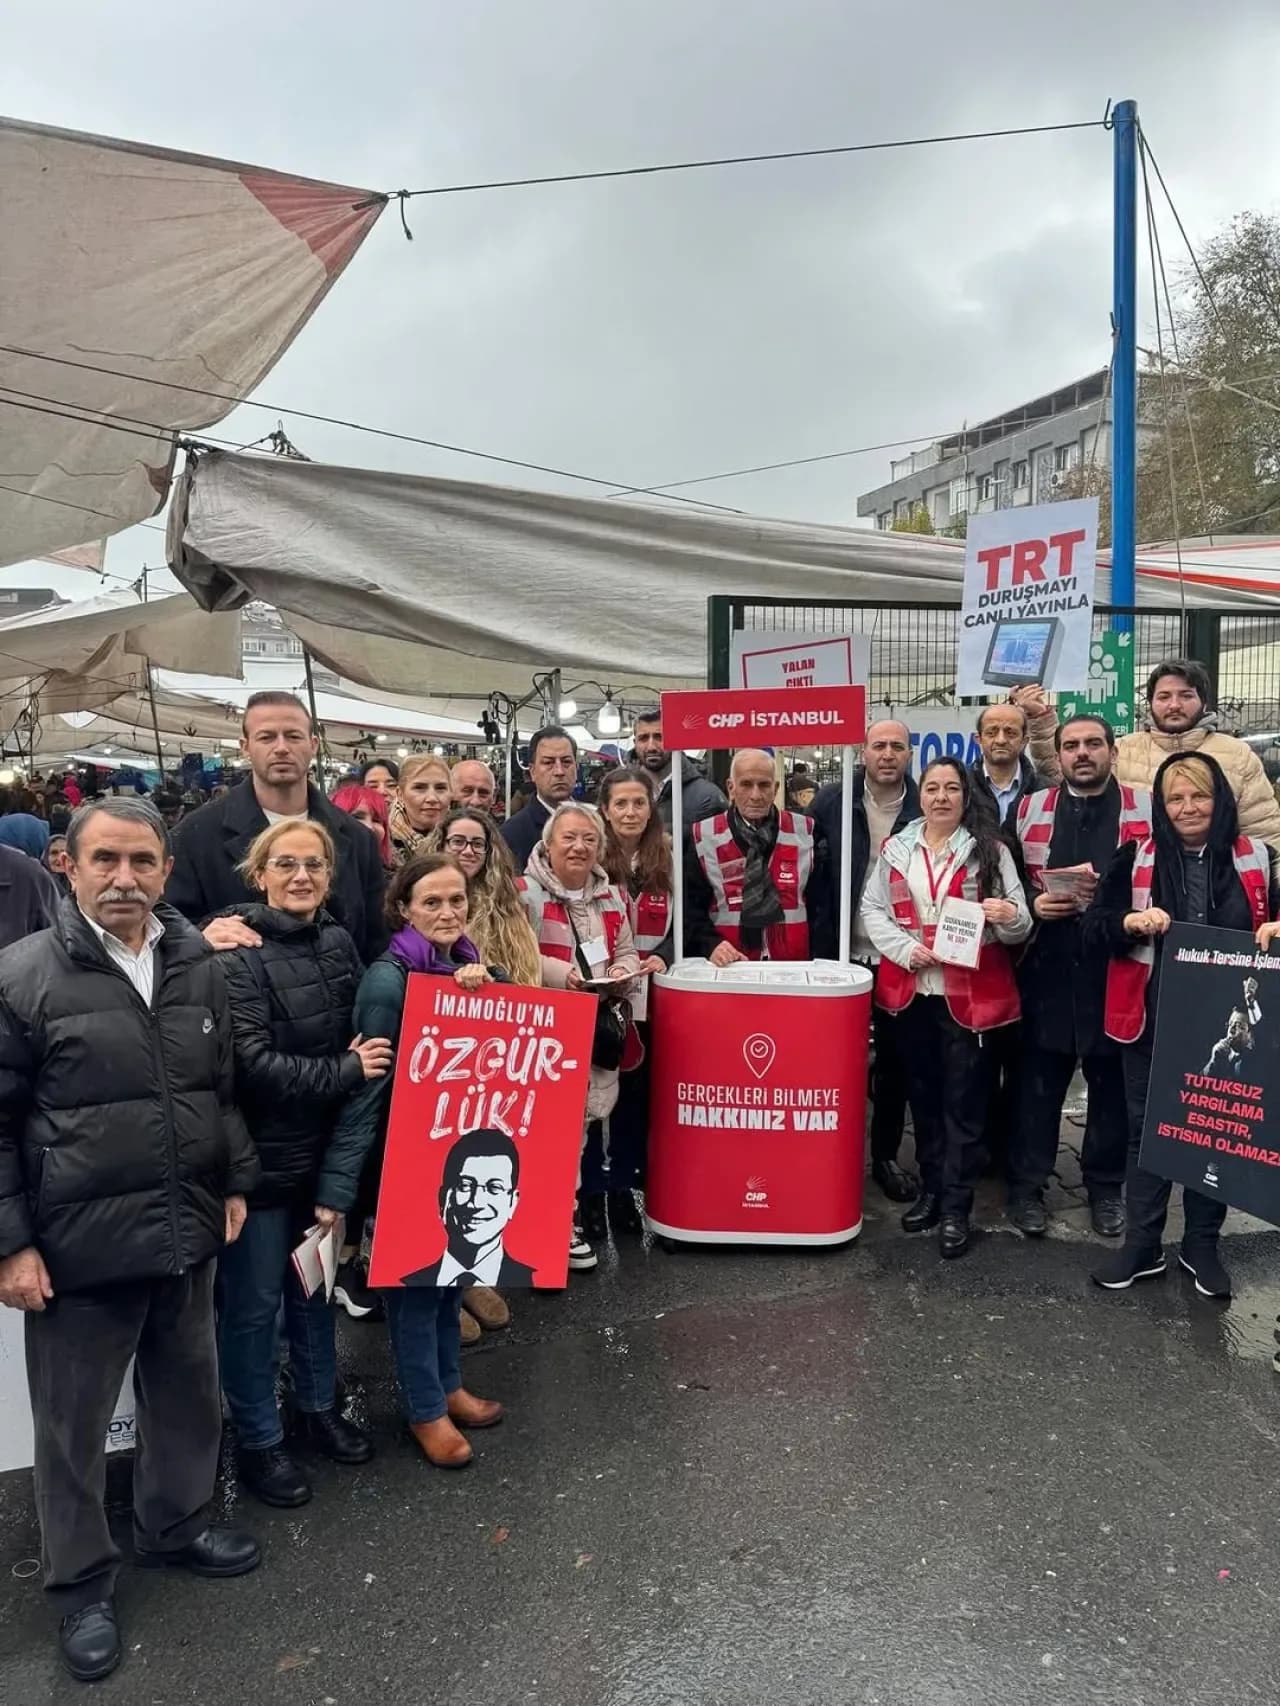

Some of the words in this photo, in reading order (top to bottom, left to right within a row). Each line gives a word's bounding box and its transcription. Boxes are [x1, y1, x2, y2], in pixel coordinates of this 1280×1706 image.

[977, 529, 1087, 591] TRT
[978, 577, 1078, 609] DURUŞMAYI
[964, 609, 1012, 628] CANLI
[1016, 593, 1090, 619] YAYINLA
[708, 713, 744, 728] CHP
[751, 710, 844, 727] İSTANBUL
[1177, 947, 1211, 964] Hukuk
[1212, 950, 1252, 967] Tersine
[434, 989, 555, 1028] İMAMOĞLU'NA
[409, 1025, 578, 1085] ÖZGÜR-
[677, 1082, 768, 1105] GERÇEKLERİ
[773, 1087, 840, 1107] BİLMEYE
[1184, 1072, 1264, 1100] TUTUKSUZ
[429, 1083, 536, 1139] LÜK!
[677, 1104, 786, 1130] HAKKINIZ
[792, 1110, 839, 1131] VAR
[1179, 1090, 1265, 1121] YARGILAMA
[1157, 1121, 1212, 1148] İSTİSNA
[1187, 1111, 1252, 1140] ESASTIR,
[745, 1192, 768, 1201] CHP
